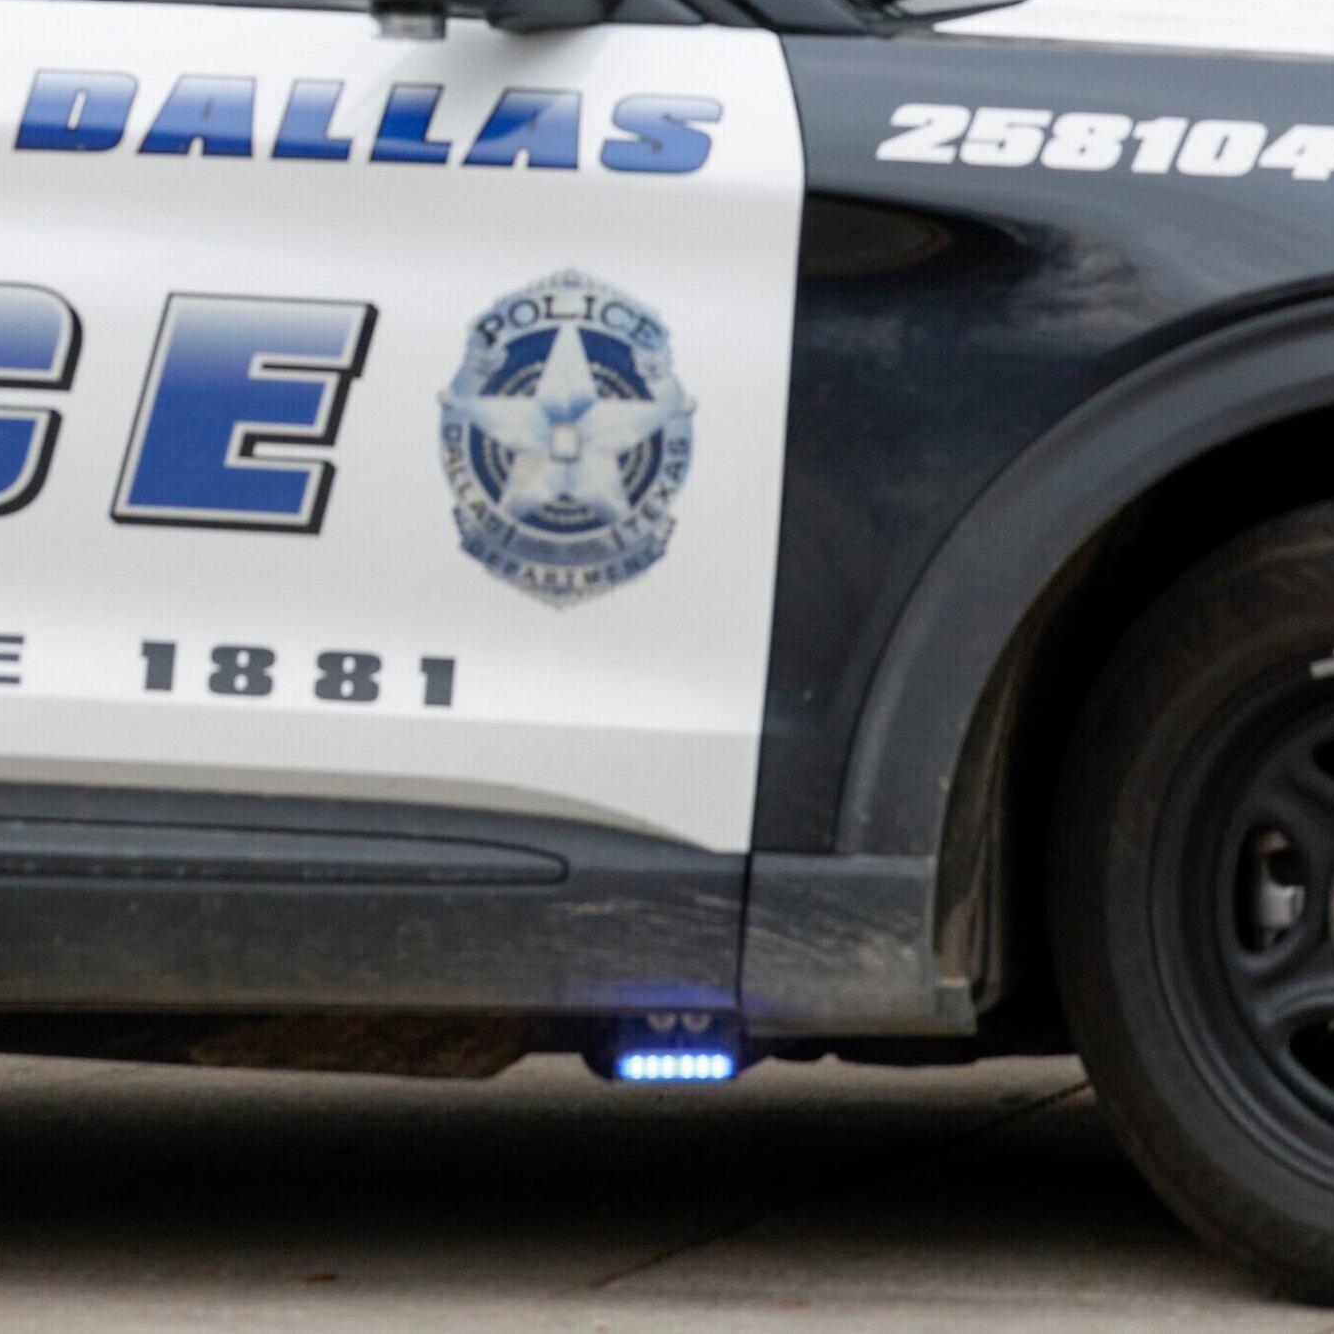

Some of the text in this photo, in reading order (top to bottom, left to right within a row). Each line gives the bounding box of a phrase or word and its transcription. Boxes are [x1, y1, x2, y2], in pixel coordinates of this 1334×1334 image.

[14, 69, 724, 174] DALLAS
[474, 294, 669, 350] POLICE
[441, 423, 504, 534] DALLAS
[140, 641, 457, 708] 1881
